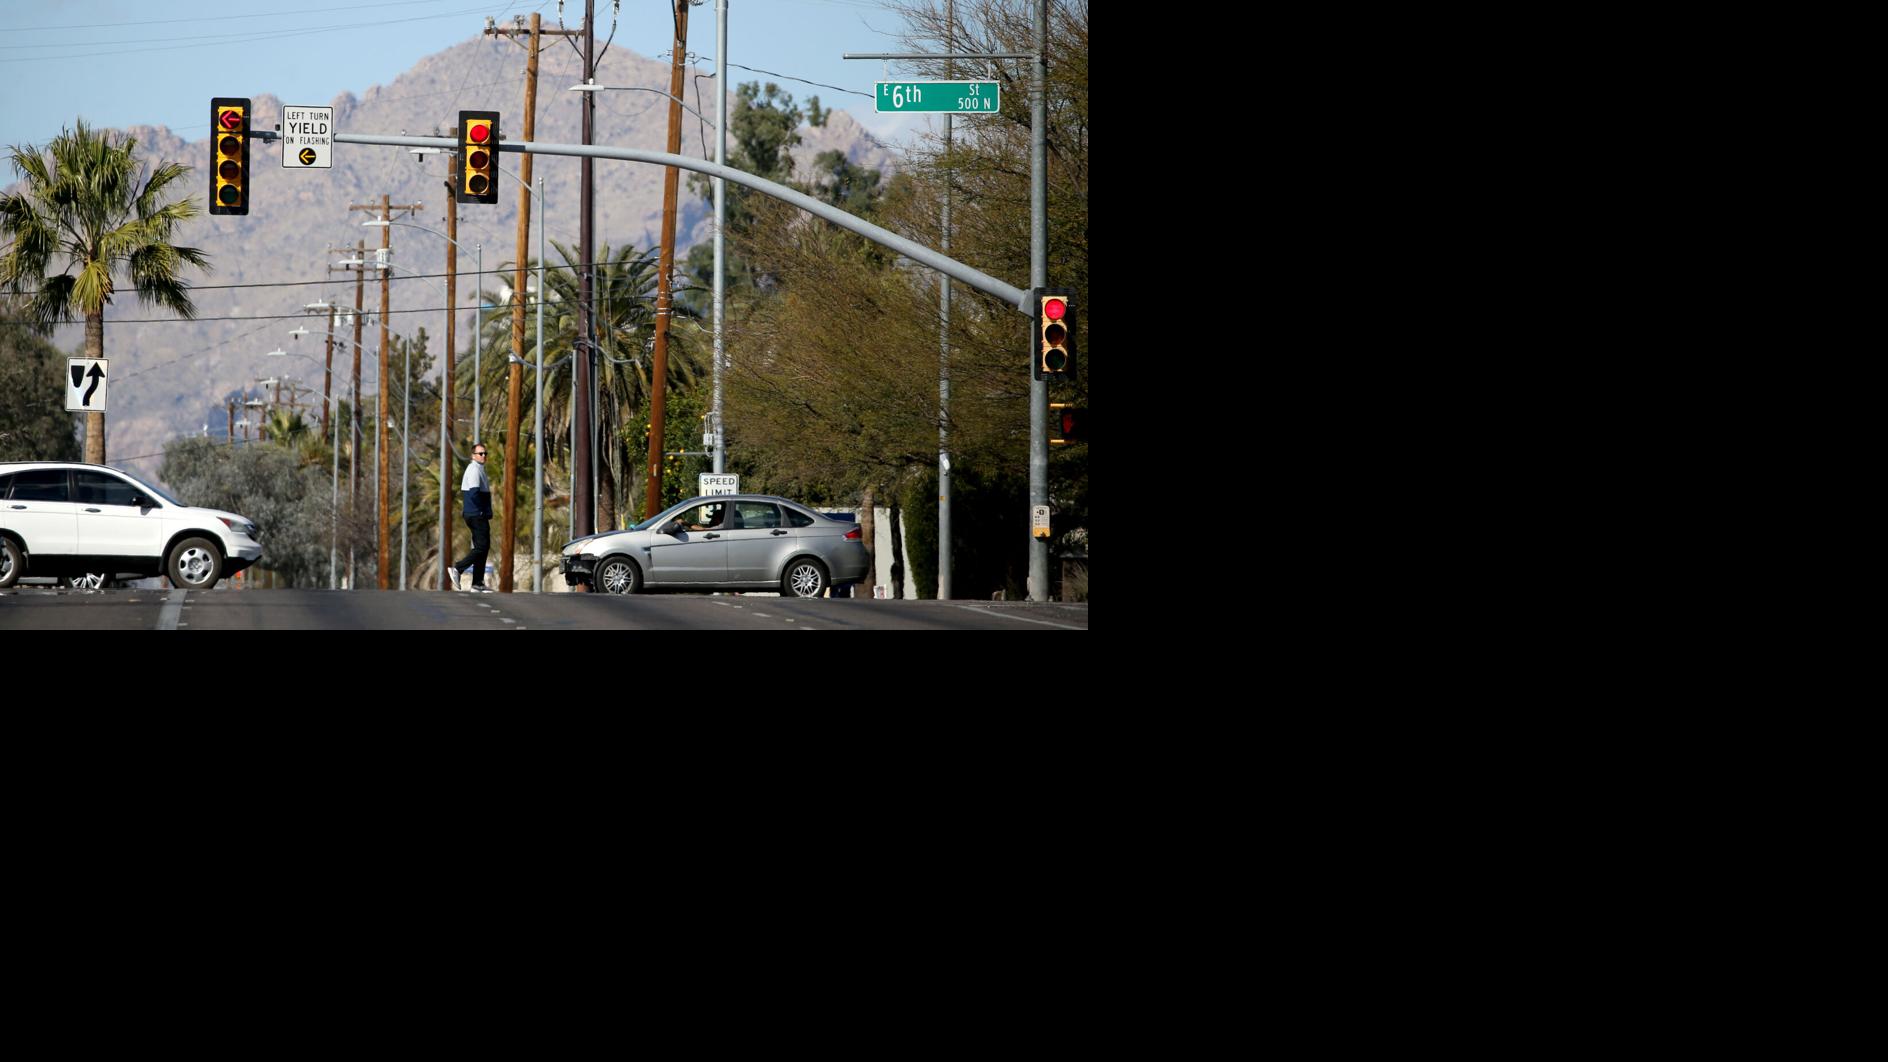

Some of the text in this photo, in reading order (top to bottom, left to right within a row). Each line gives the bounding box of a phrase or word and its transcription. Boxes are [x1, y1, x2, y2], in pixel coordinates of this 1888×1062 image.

[884, 84, 980, 108] E 6th St
[958, 98, 990, 110] 500 N
[288, 112, 328, 120] LEFT TURN
[289, 122, 328, 134] YIELD
[286, 136, 330, 146] ON FLASHING
[704, 478, 735, 486] SPEED
